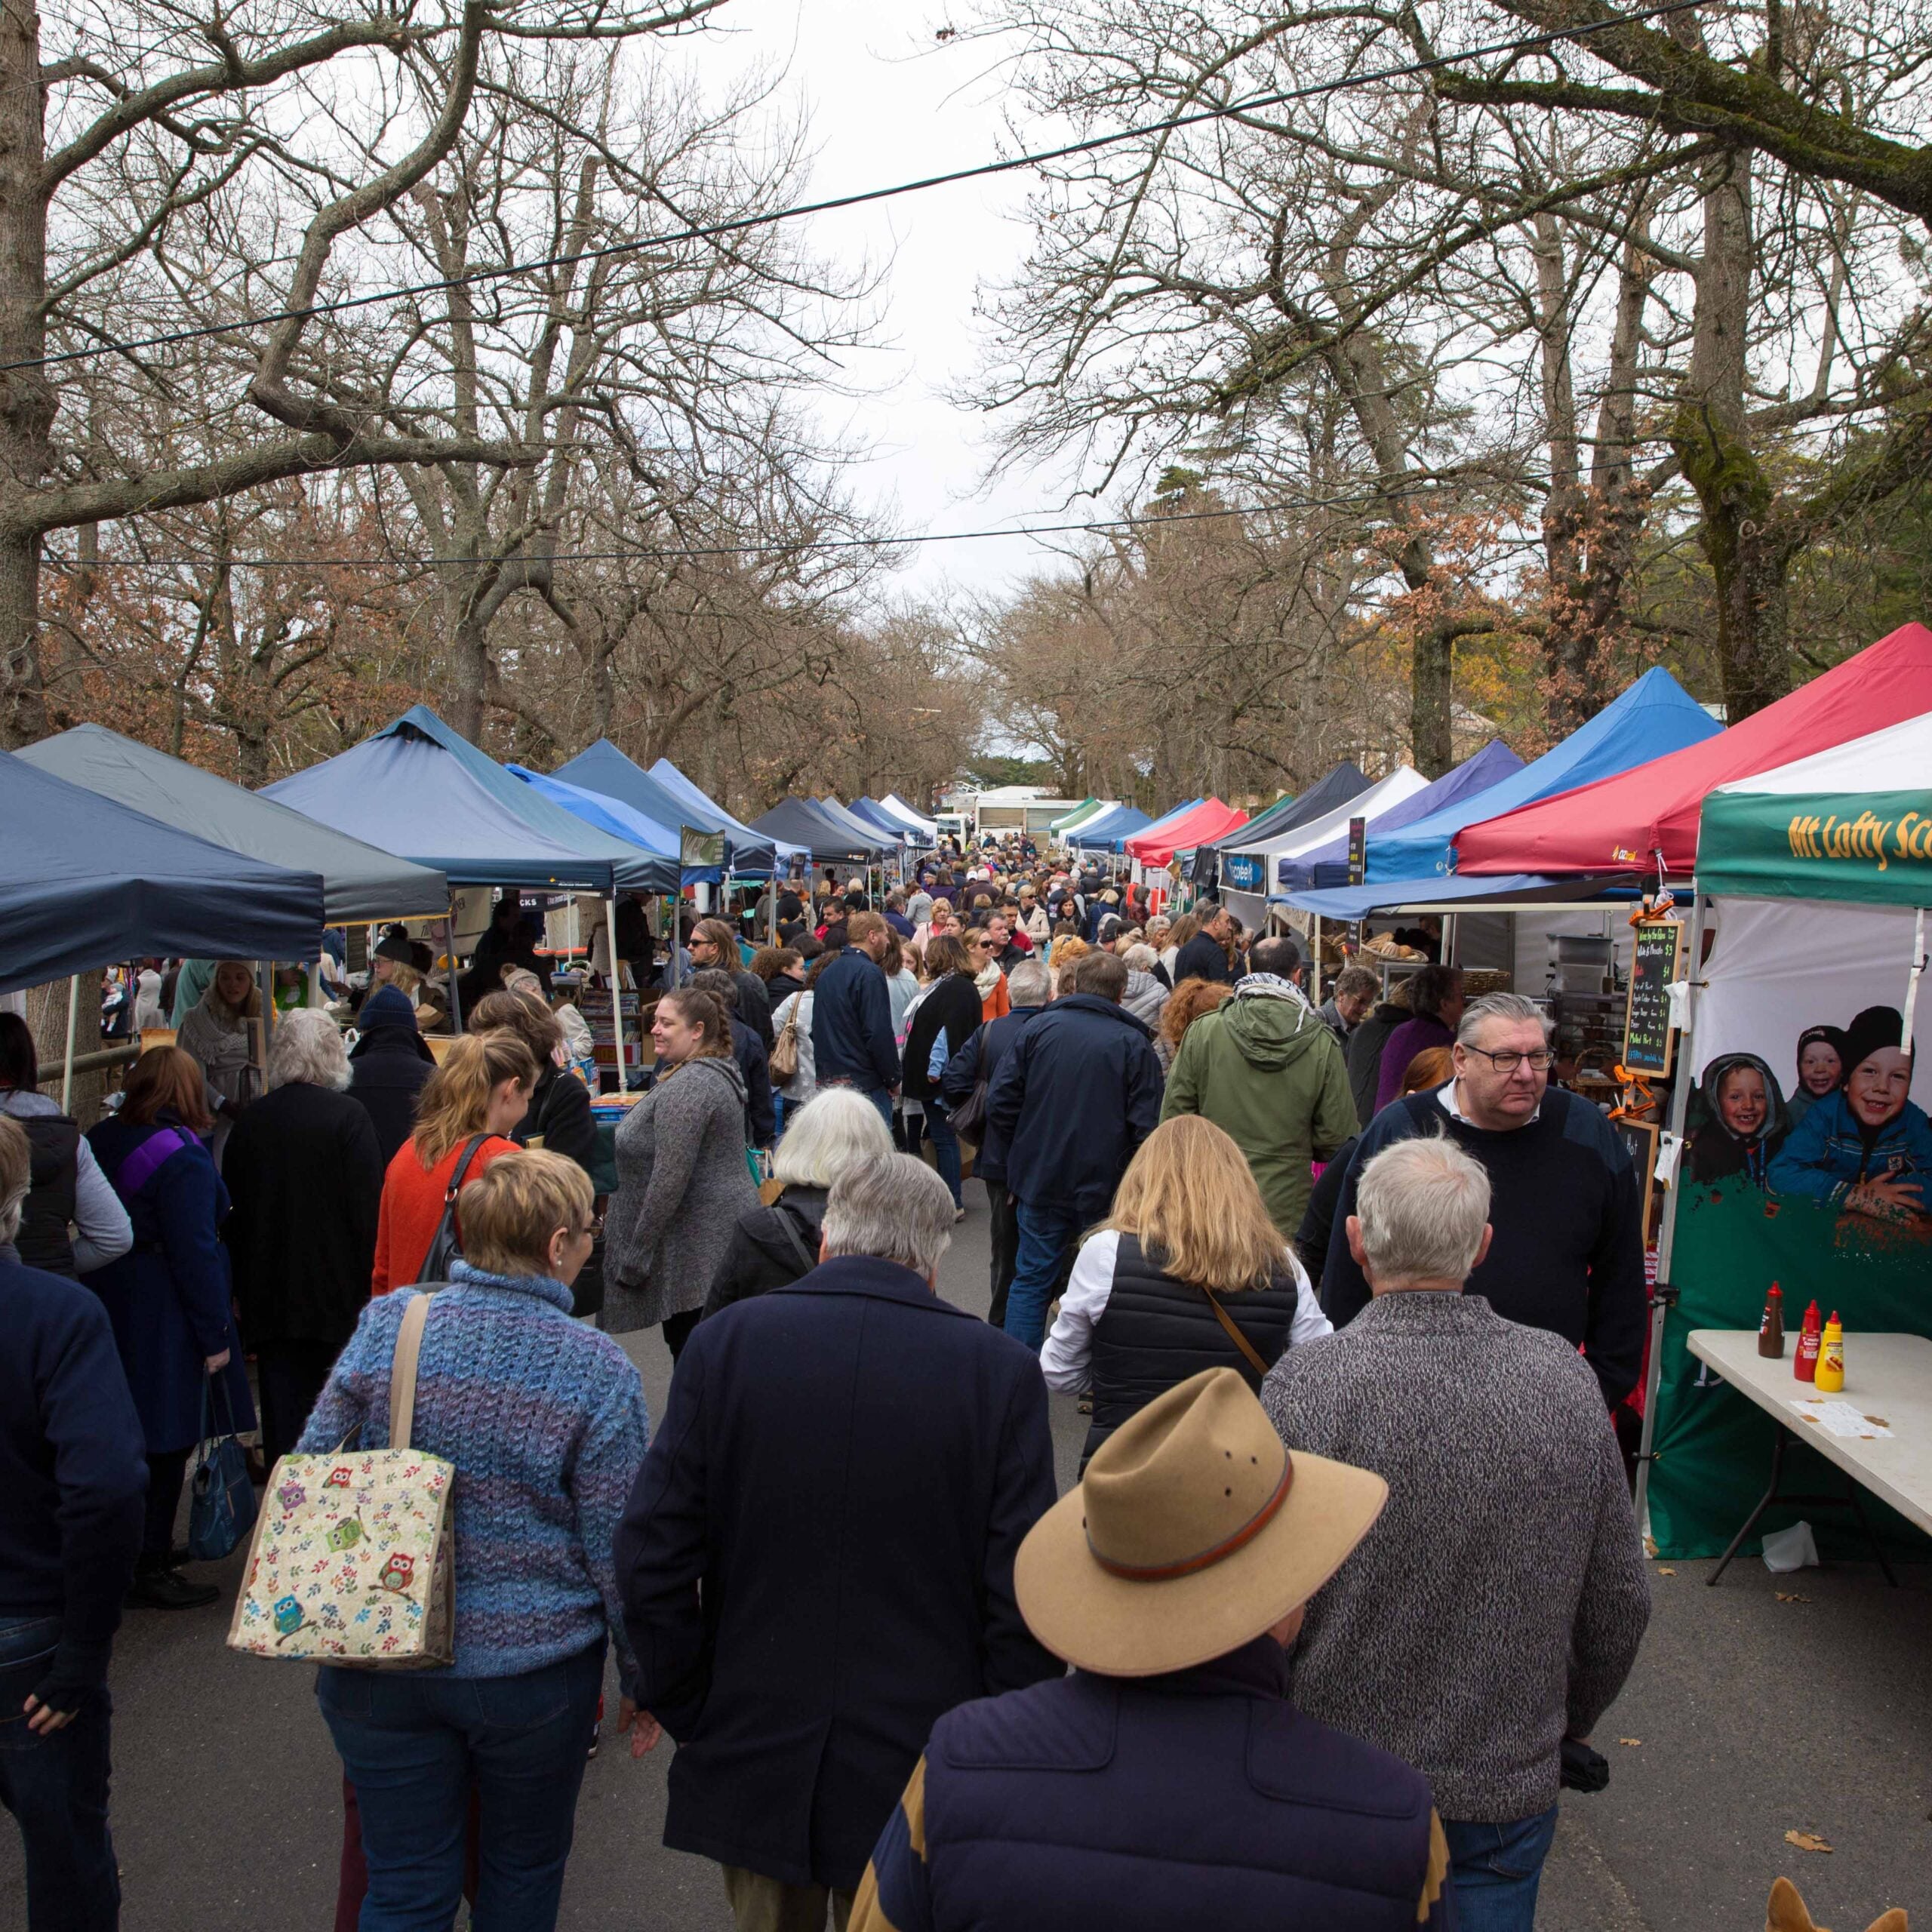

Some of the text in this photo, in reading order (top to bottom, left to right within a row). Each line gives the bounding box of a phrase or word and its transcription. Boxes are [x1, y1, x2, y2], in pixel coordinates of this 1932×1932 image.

[1788, 816, 1822, 858] Mt
[1823, 811, 1893, 872] Lofty
[519, 898, 537, 906] CKS
[1630, 1019, 1640, 1028] Beer
[1626, 1134, 1638, 1155] Hot
